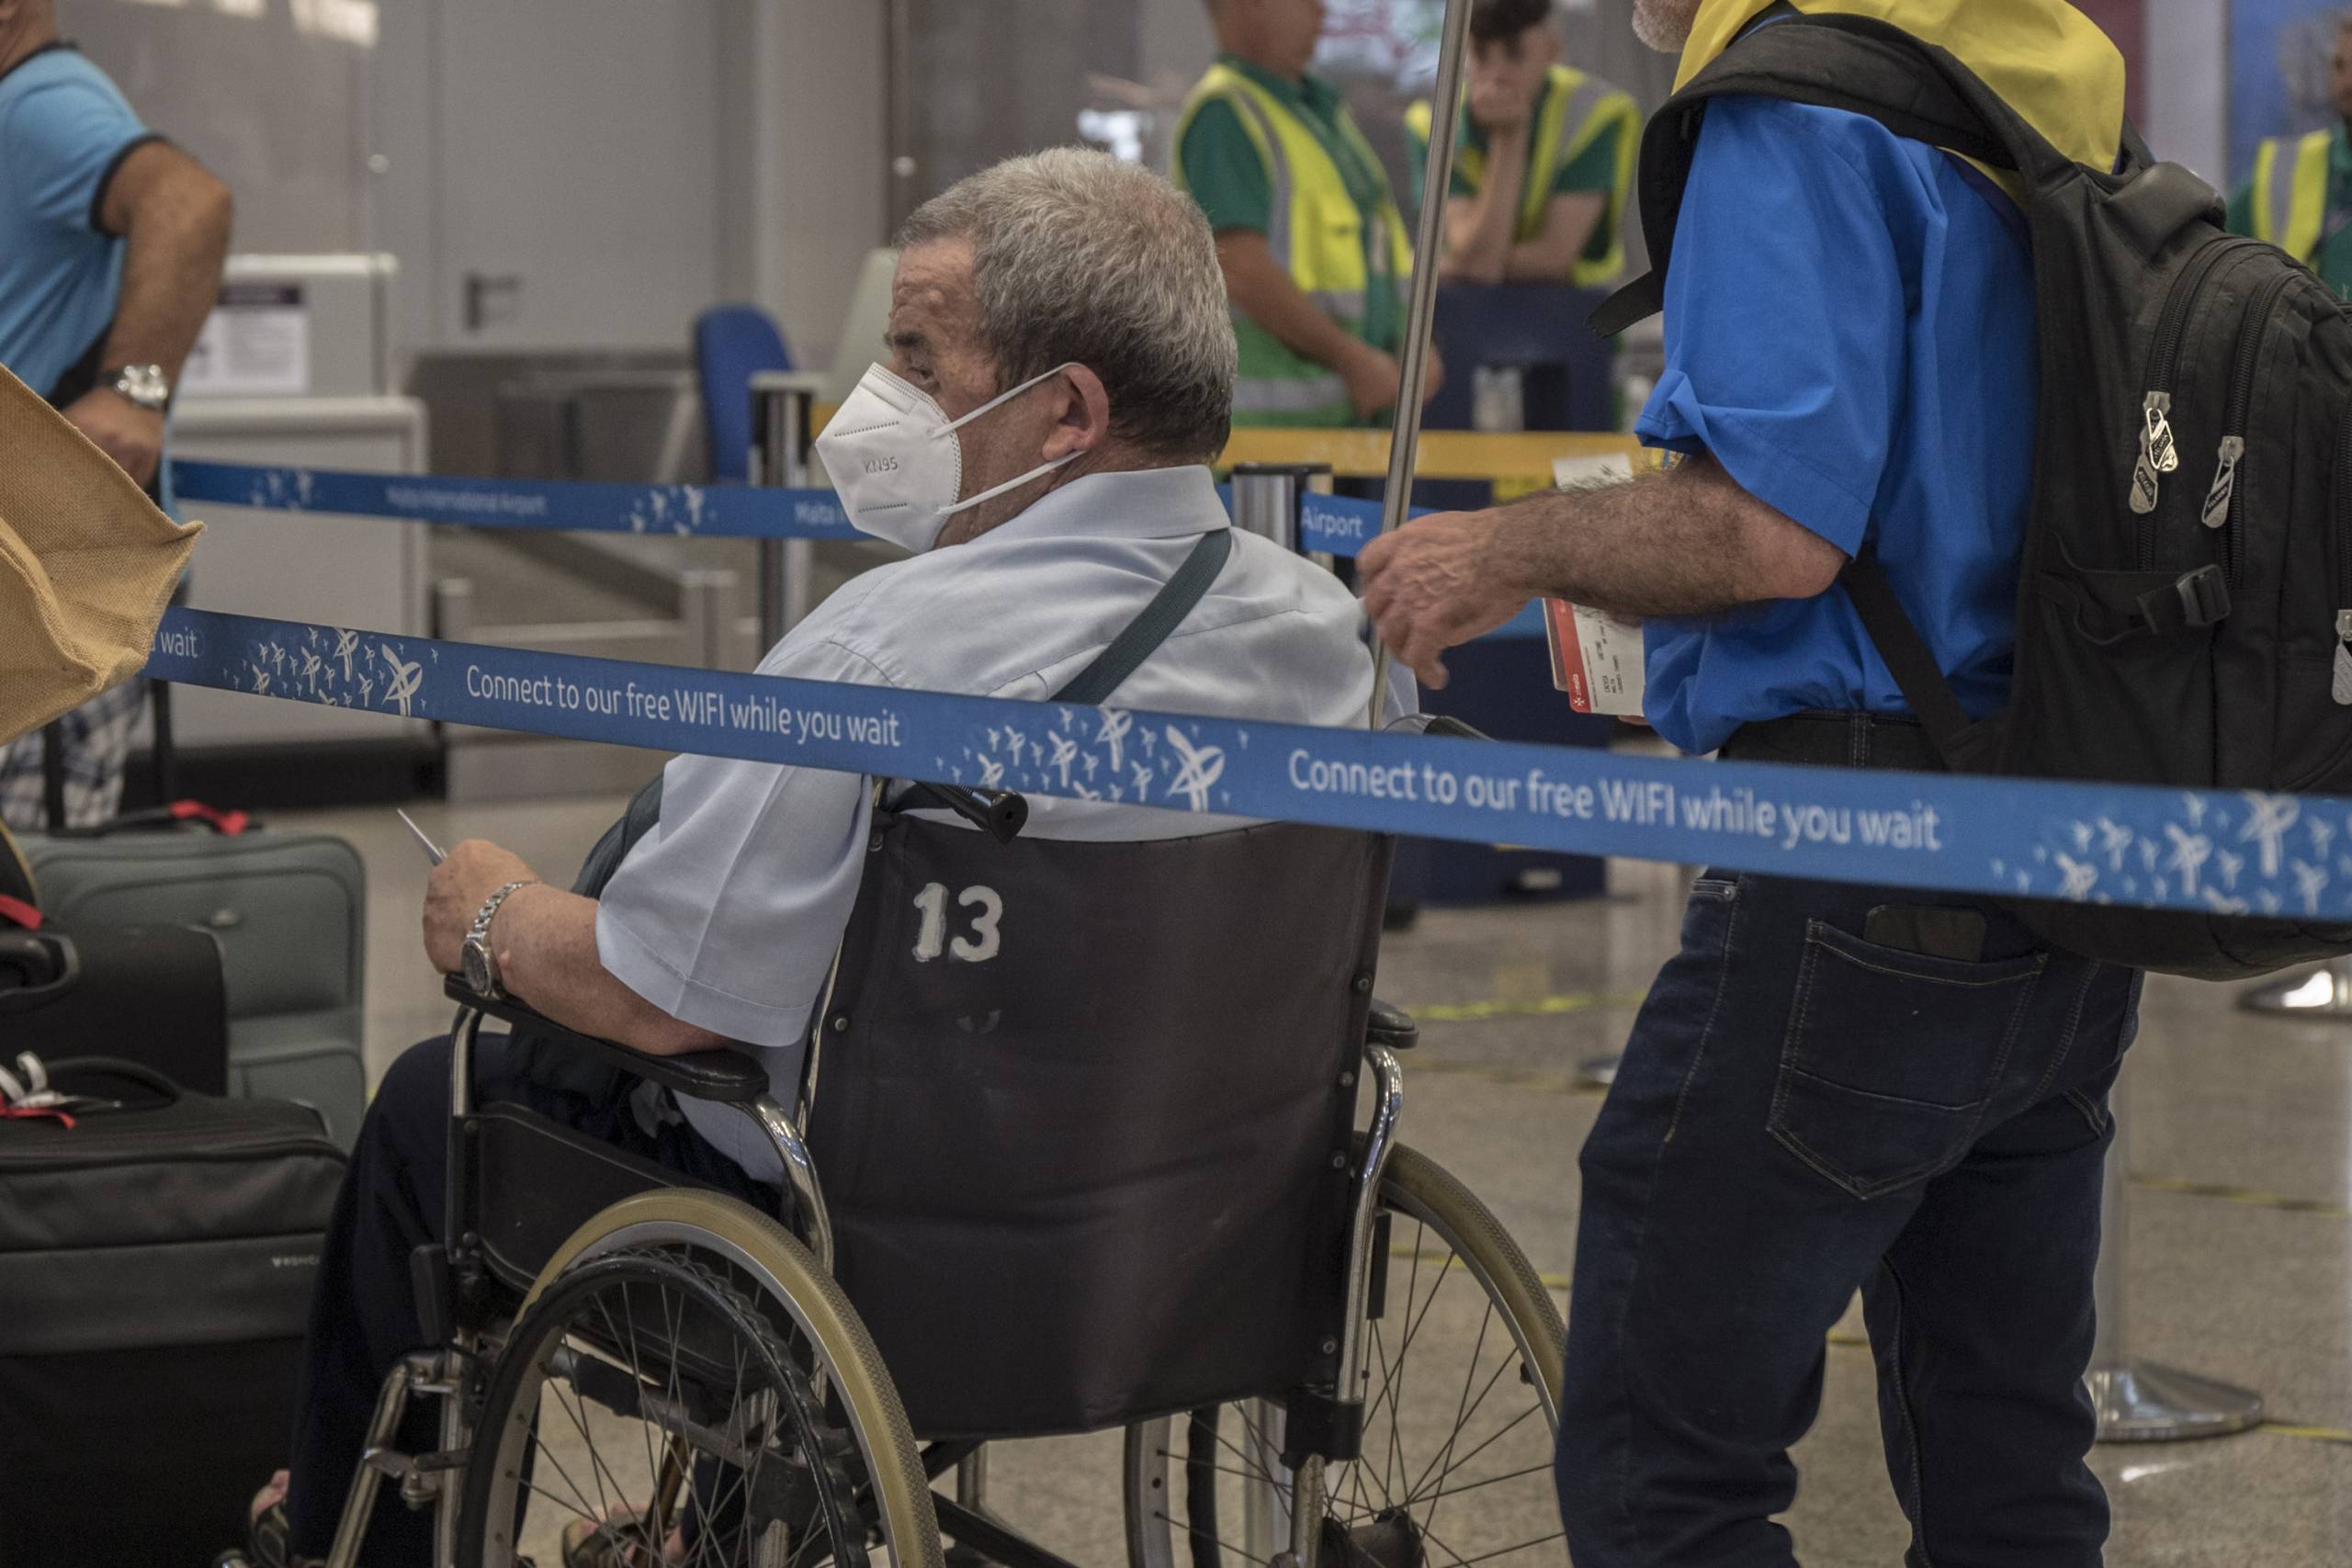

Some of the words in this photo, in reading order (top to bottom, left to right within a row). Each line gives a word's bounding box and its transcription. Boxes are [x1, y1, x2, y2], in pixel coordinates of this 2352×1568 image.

[865, 457, 899, 474] KN95
[1301, 506, 1363, 539] Airport
[160, 625, 198, 659] wait
[466, 664, 553, 706] Connect
[557, 676, 580, 710] to
[585, 686, 622, 716] our
[626, 681, 671, 721] free
[673, 689, 725, 728] WIFI
[729, 694, 792, 735] while
[797, 710, 842, 745] you
[846, 708, 901, 748] wait
[1288, 748, 1418, 801] Connect
[1421, 761, 1458, 805] to
[1464, 774, 1521, 811] our
[1525, 768, 1595, 820] free
[1599, 778, 1676, 827] WIFI
[1680, 785, 1777, 838] while
[1781, 803, 1852, 851] you
[1856, 798, 1942, 852] wait
[911, 882, 1003, 964] 13
